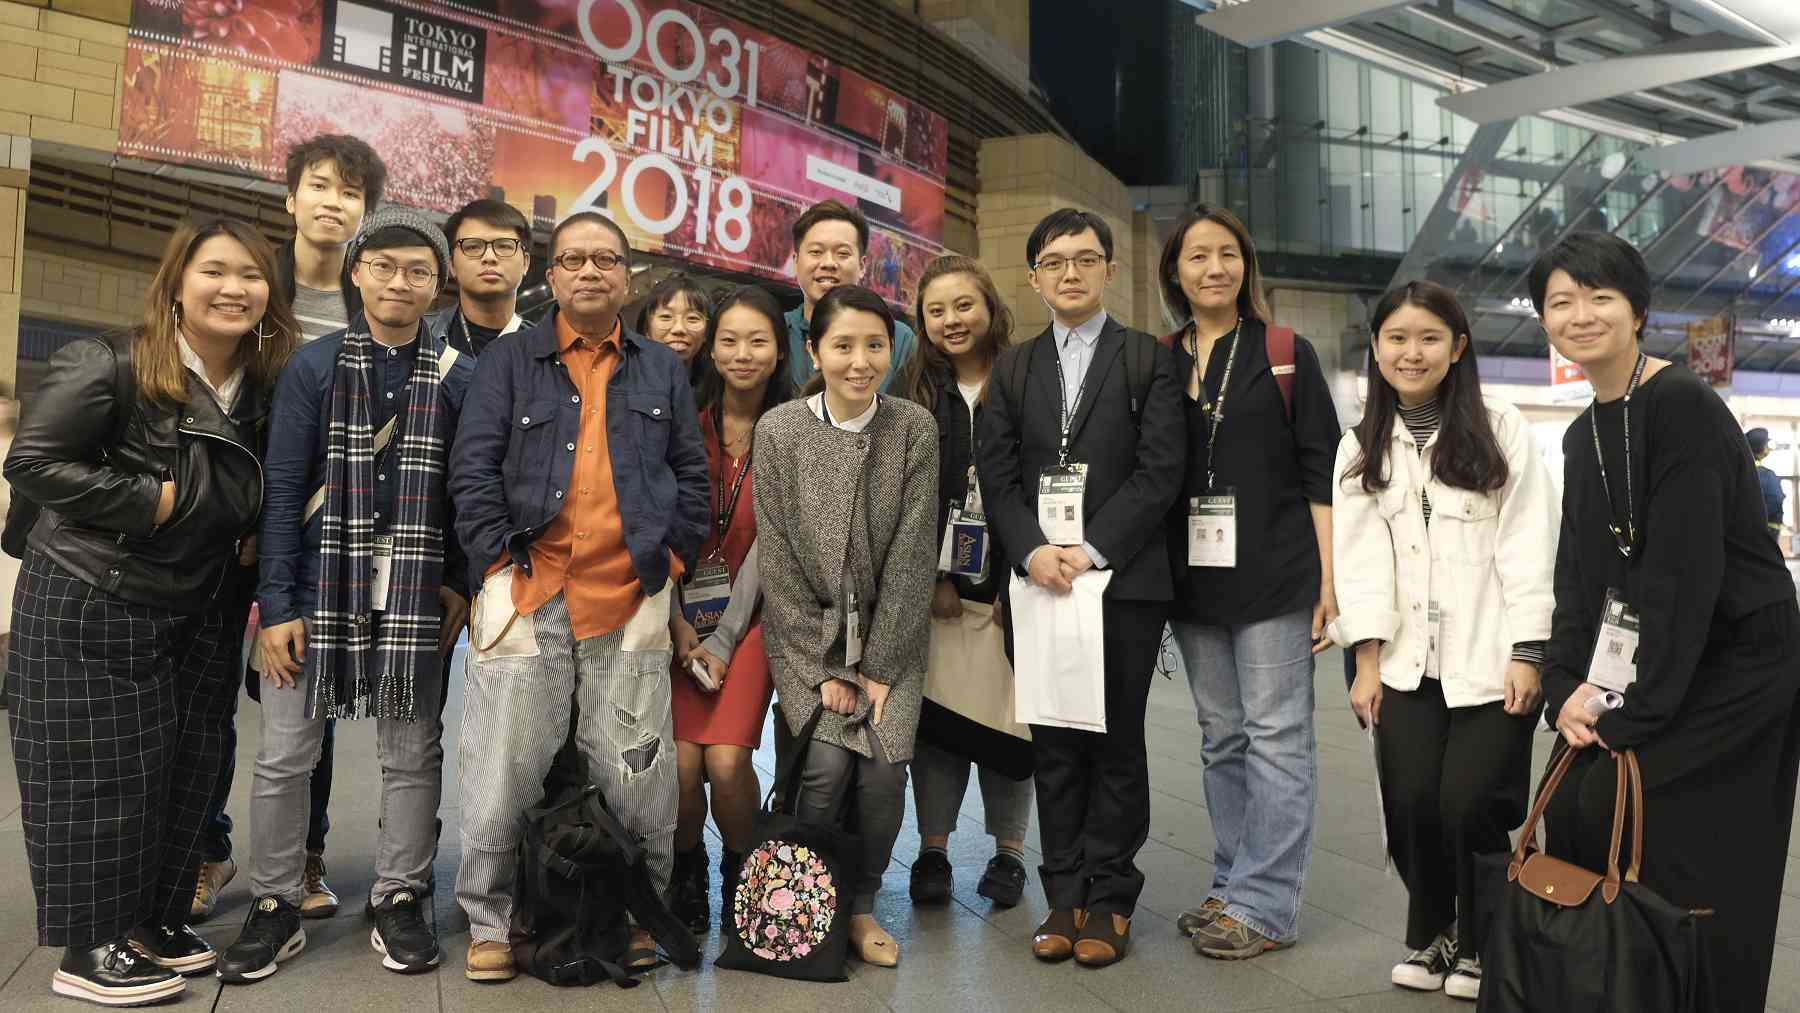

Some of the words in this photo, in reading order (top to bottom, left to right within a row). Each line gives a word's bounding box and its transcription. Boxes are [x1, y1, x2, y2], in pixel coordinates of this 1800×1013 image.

[403, 32, 475, 59] INTERNATIONAL
[404, 17, 477, 50] TOKYO
[577, 0, 759, 107] 0031
[402, 42, 475, 83] FILM
[402, 66, 474, 94] FESTIVAL
[606, 63, 733, 134] TOKYO
[625, 108, 715, 168] FILM
[565, 137, 753, 254] 2018
